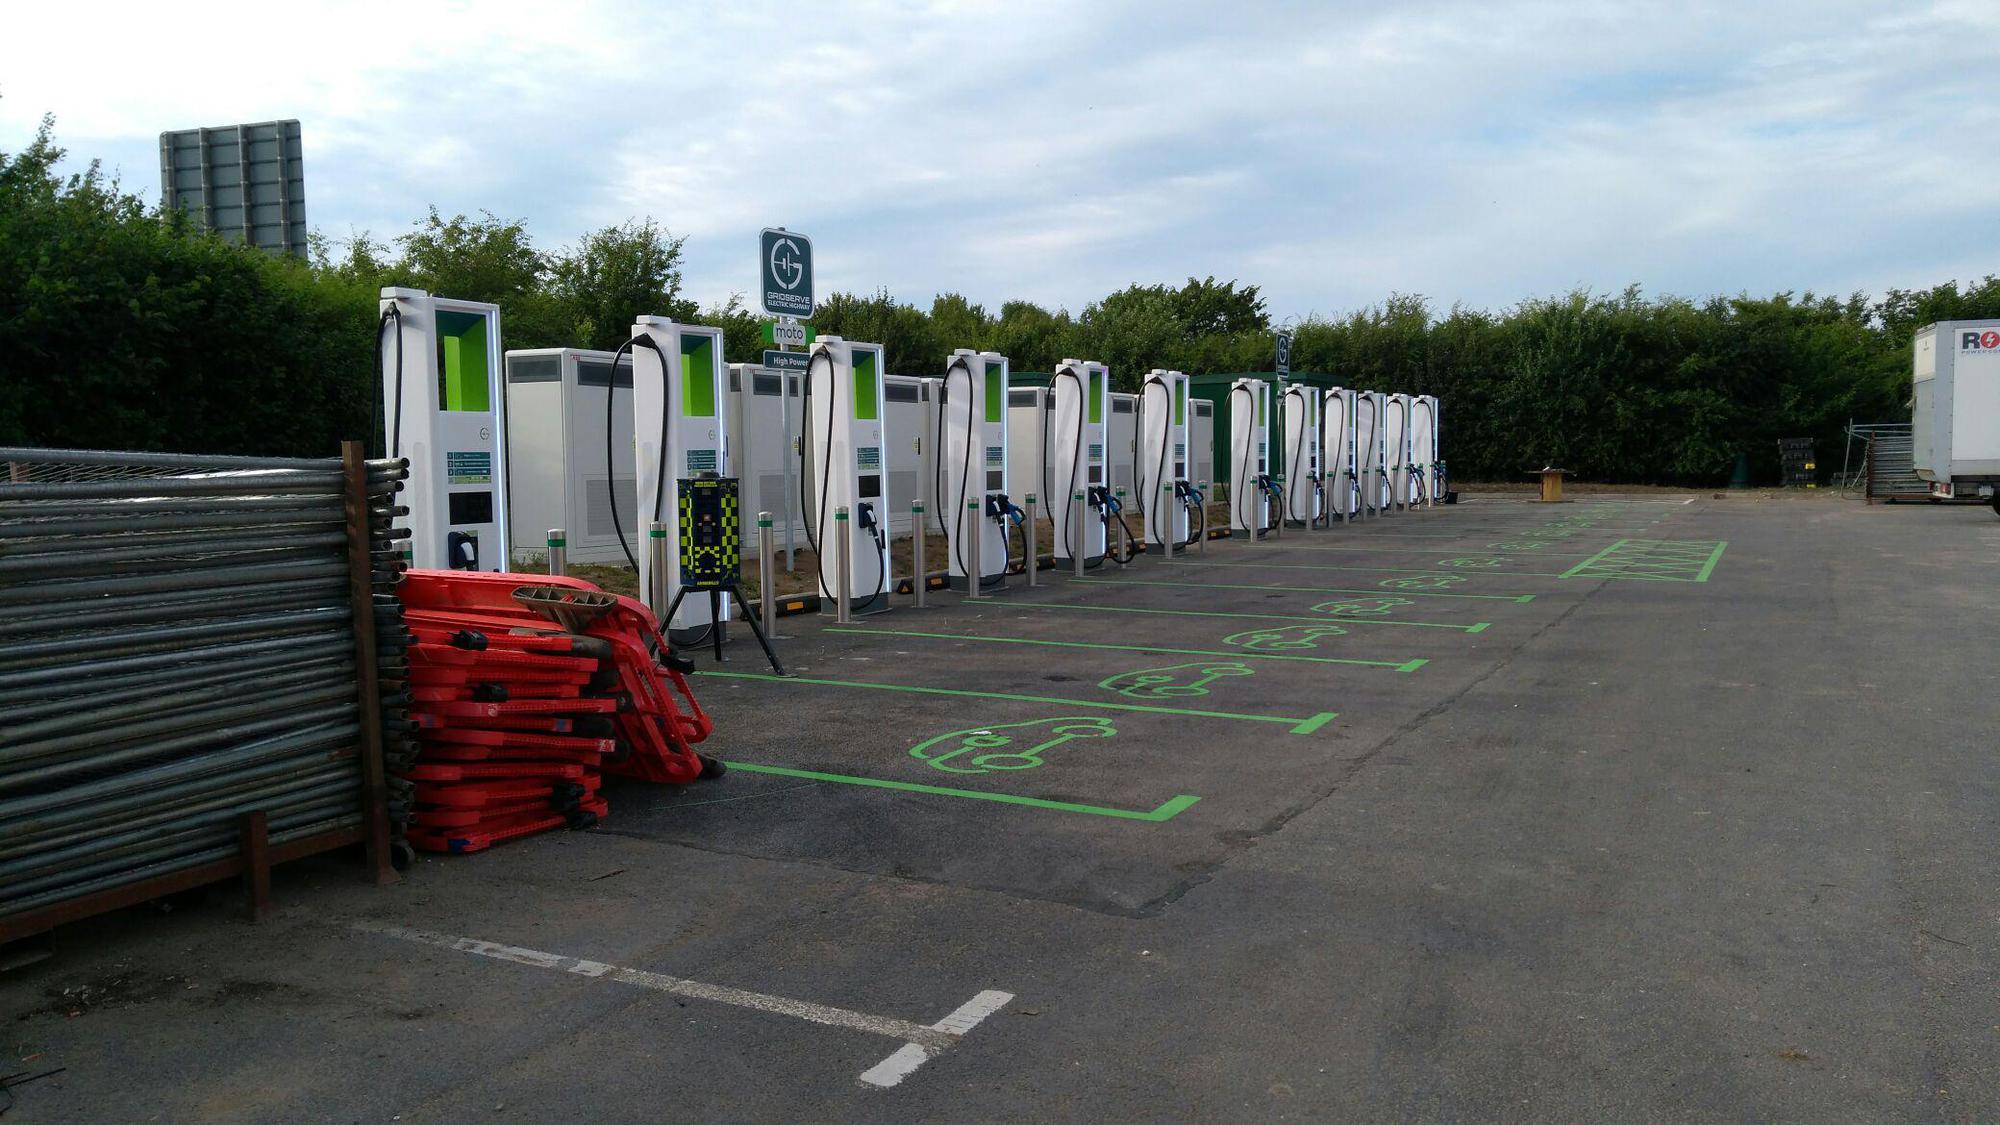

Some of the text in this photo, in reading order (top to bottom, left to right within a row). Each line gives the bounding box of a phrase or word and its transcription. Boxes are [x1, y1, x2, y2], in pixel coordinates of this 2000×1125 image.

[767, 292, 810, 304] GRIDSERVE
[768, 299, 810, 310] ELECTRIC HIGHWAY
[776, 326, 804, 340] moto
[773, 356, 809, 367] High Power
